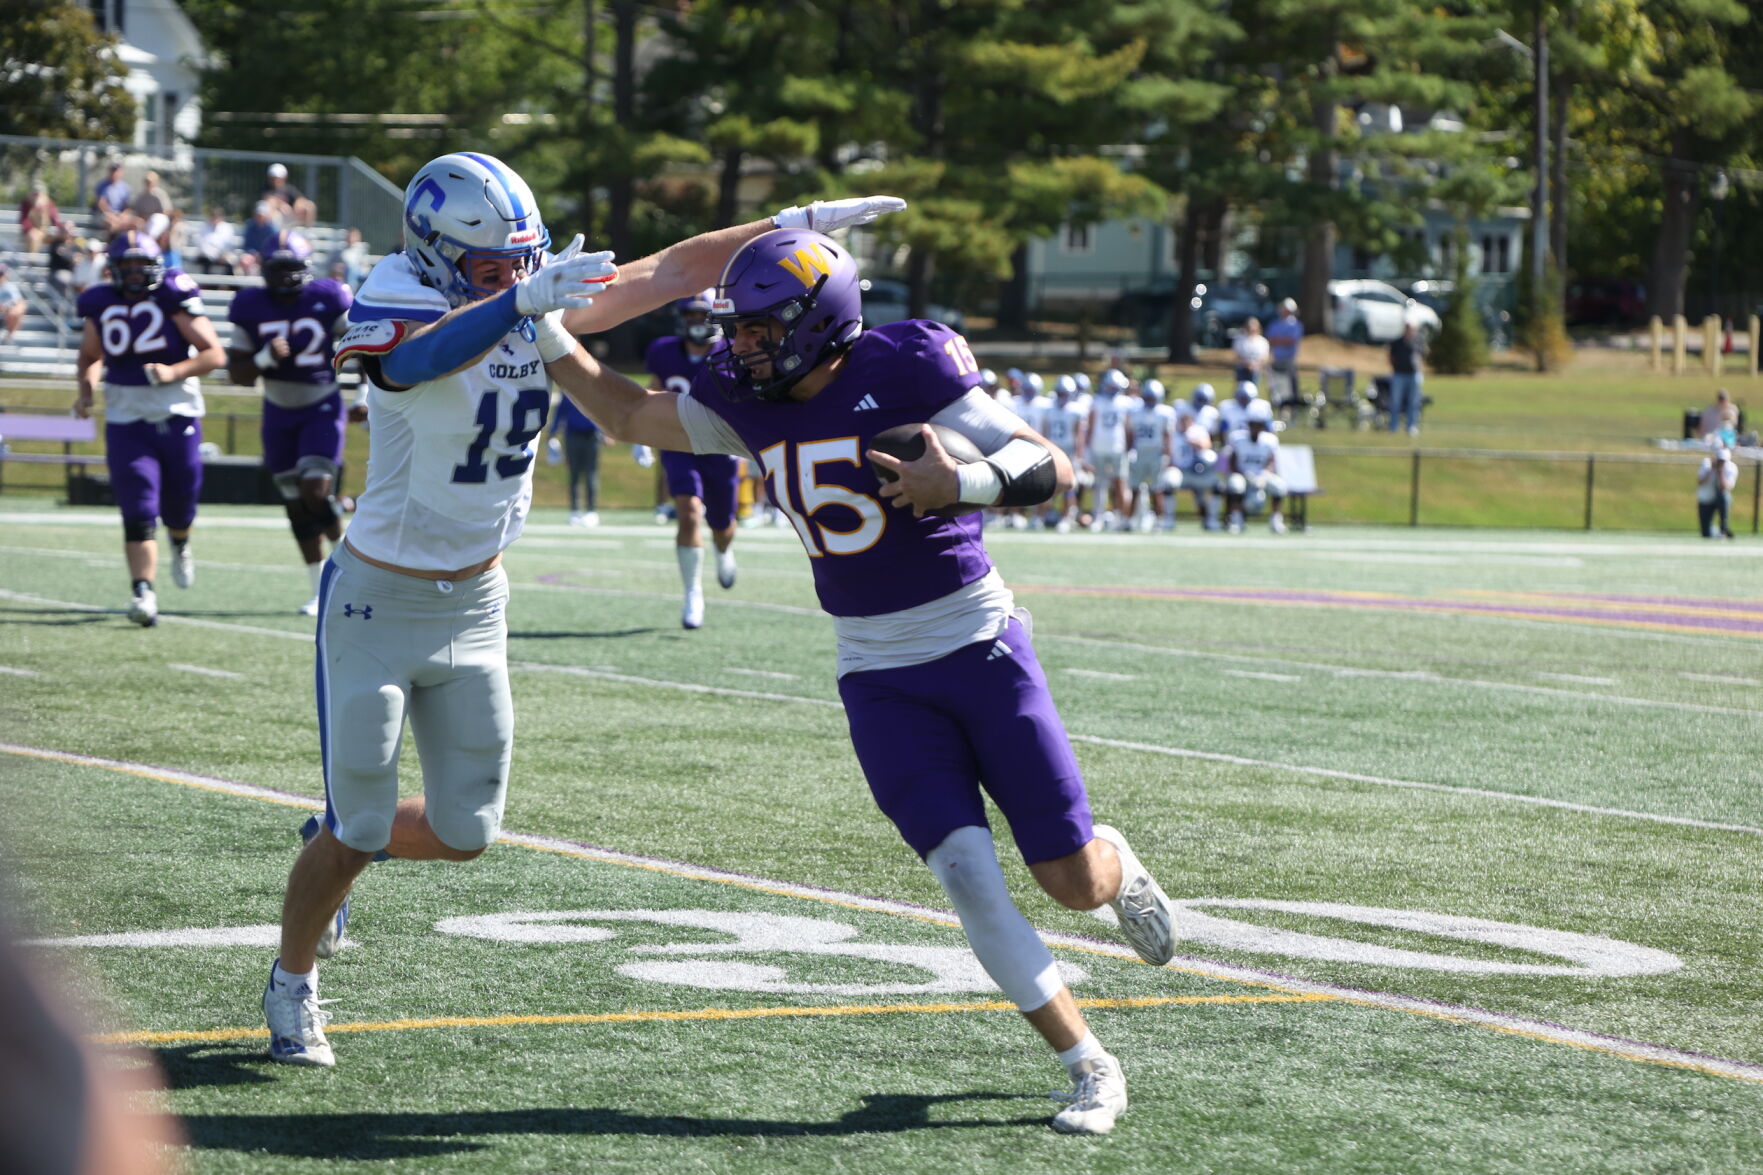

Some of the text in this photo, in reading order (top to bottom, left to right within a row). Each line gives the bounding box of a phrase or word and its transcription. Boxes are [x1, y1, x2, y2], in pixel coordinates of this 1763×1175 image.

[511, 232, 537, 244] Riddell
[776, 243, 832, 289] W
[100, 301, 168, 356] 62
[258, 317, 326, 367] 72
[489, 360, 540, 379] COLBY
[944, 335, 978, 376] 15
[450, 387, 550, 484] 19
[759, 435, 887, 557] 15
